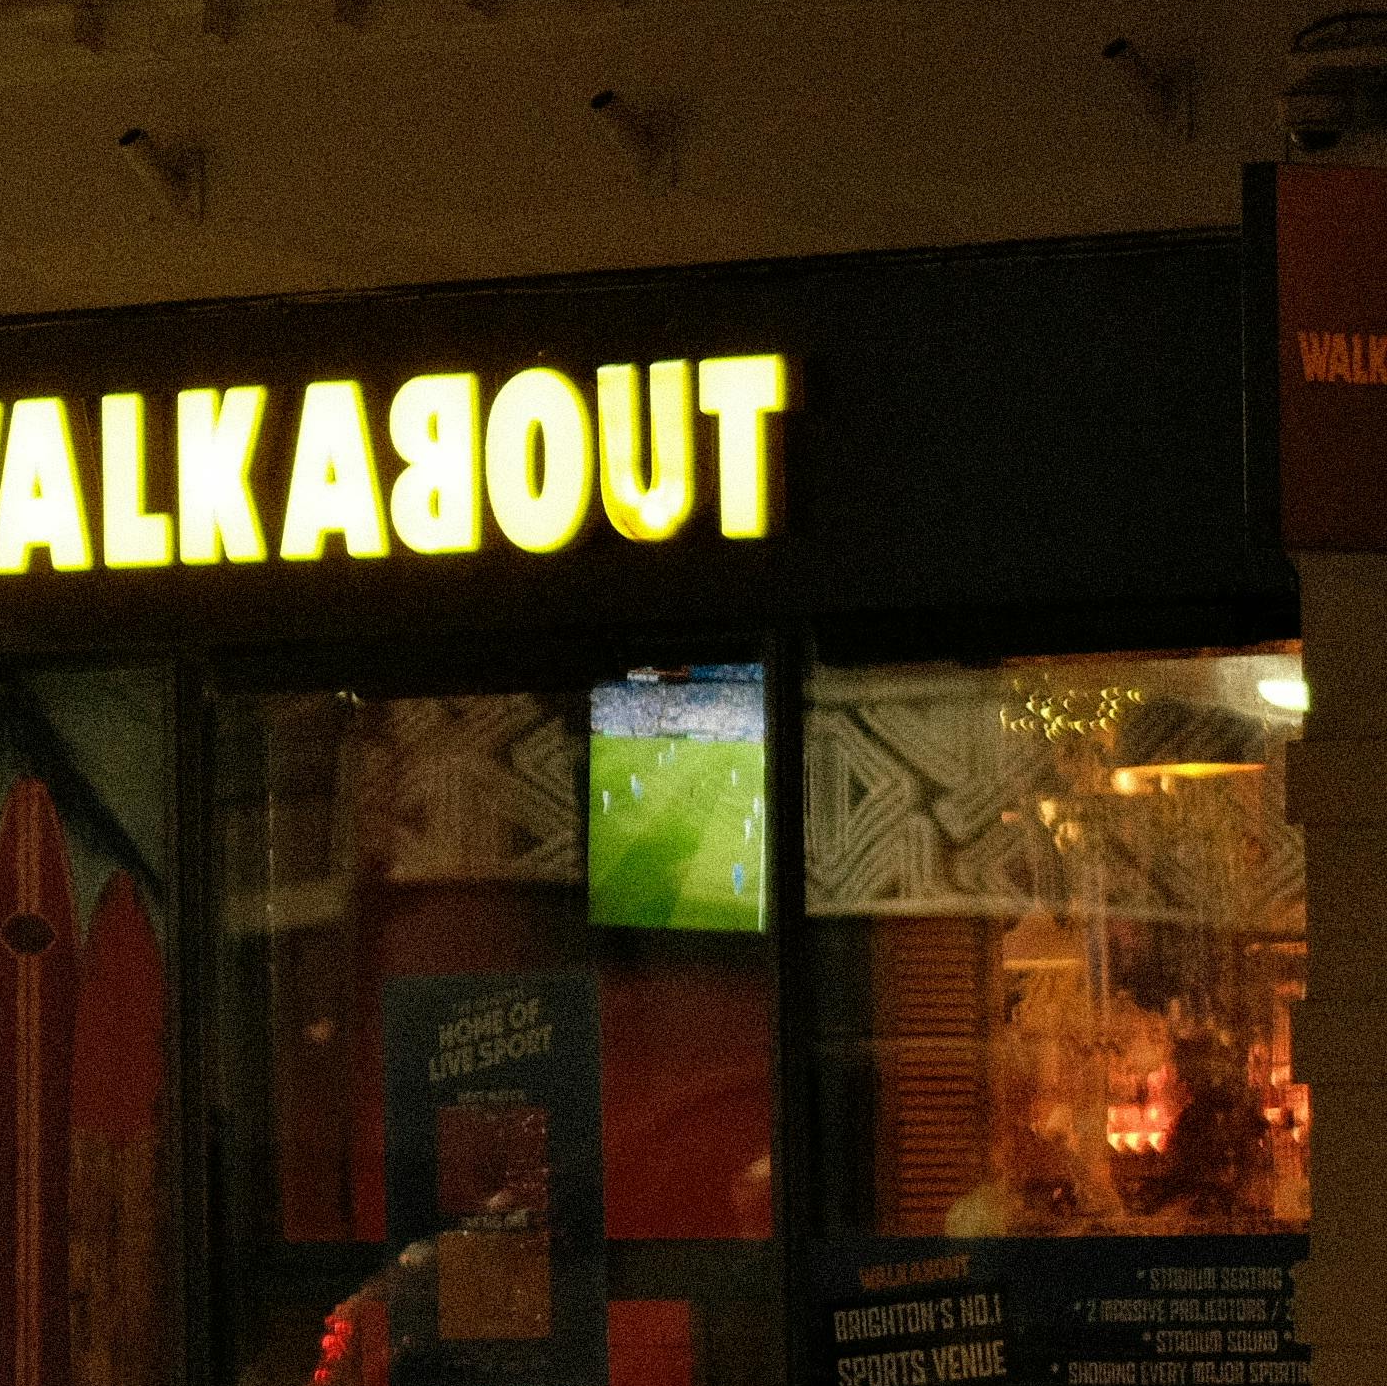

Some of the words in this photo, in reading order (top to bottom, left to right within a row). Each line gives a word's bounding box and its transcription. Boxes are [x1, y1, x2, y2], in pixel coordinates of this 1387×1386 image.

[438, 1008, 506, 1048] HOME
[509, 996, 540, 1030] OF
[428, 1045, 474, 1083] LIVE
[477, 1023, 554, 1071] SPORT
[833, 1297, 955, 1344] BRIGHTON'S
[1169, 1298, 1268, 1323] PROJECTORS
[931, 1339, 1007, 1382] VENUE
[1156, 1329, 1224, 1354] STADIUM
[1226, 1329, 1279, 1354] SOUND
[1139, 1360, 1190, 1385] EVERY
[1191, 1360, 1246, 1385] MAJOR
